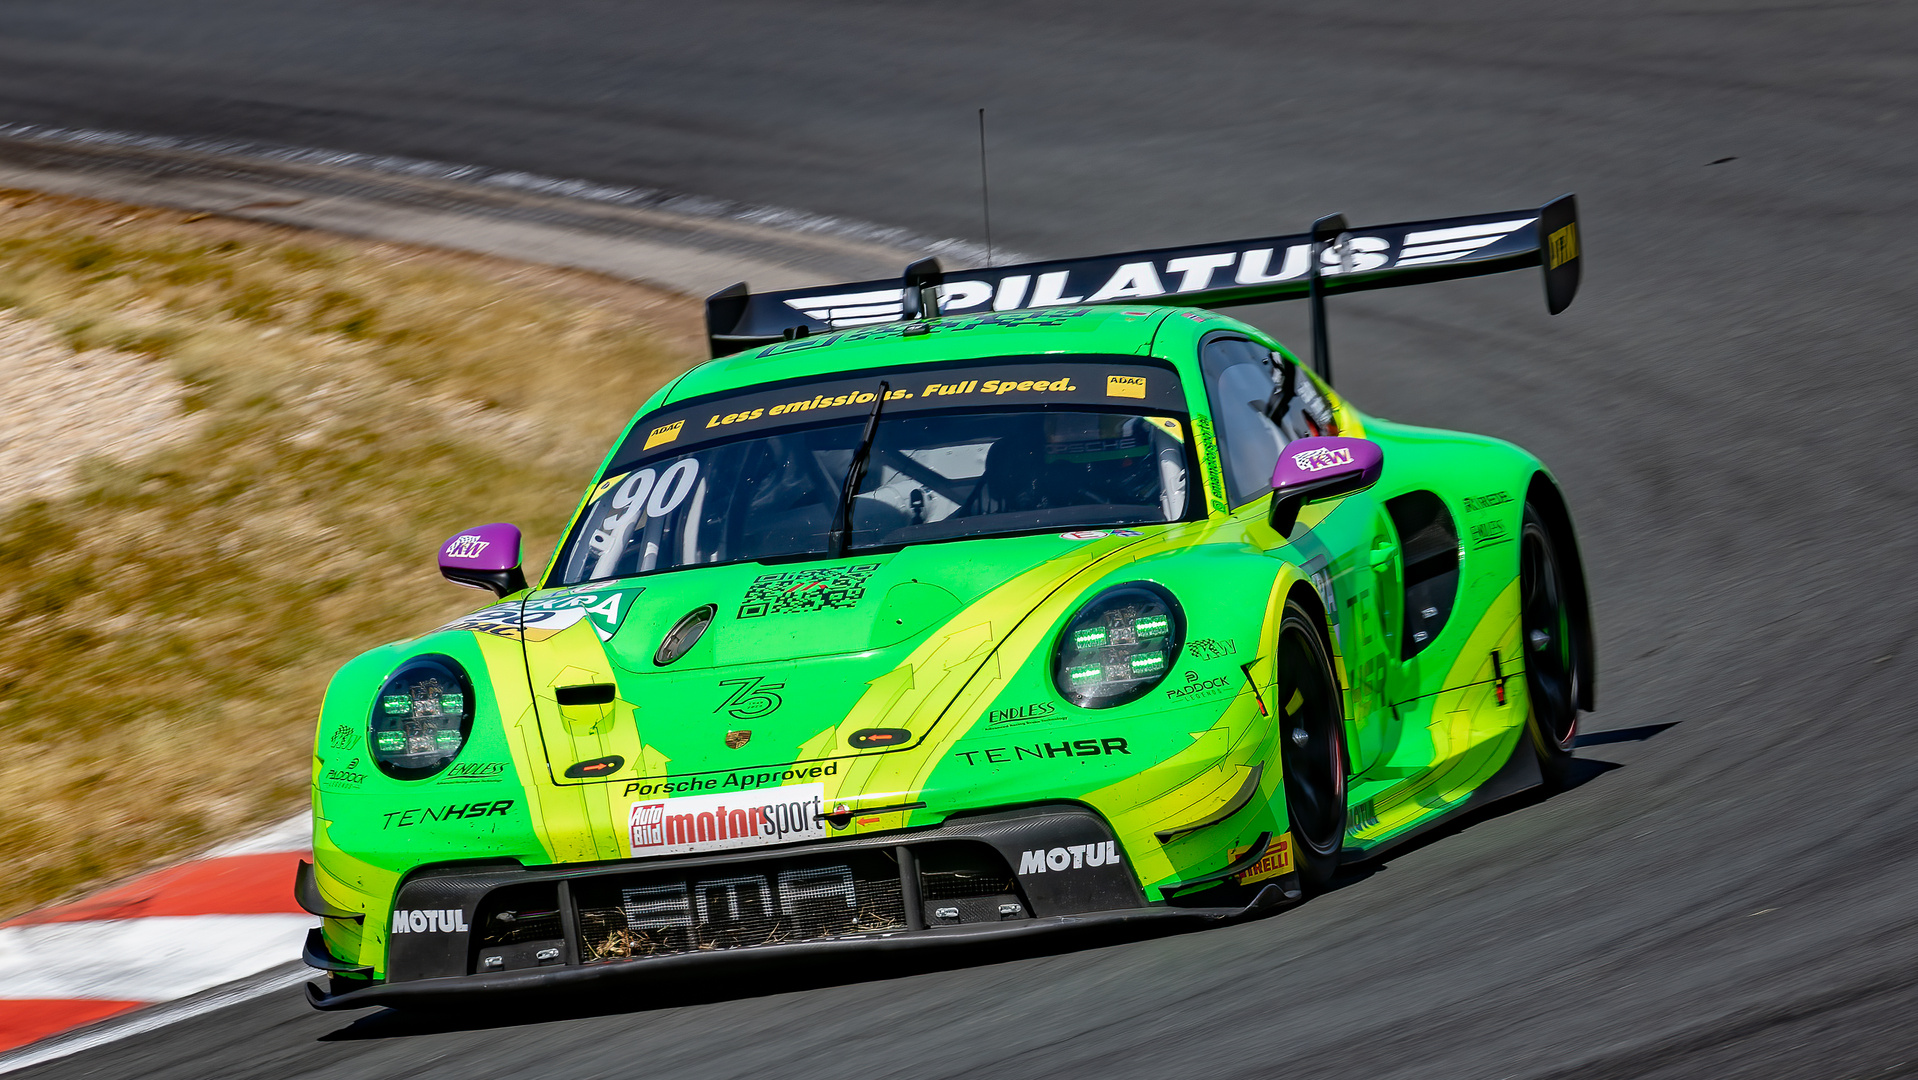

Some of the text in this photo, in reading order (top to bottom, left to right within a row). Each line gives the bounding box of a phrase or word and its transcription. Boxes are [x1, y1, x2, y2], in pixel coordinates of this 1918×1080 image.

[932, 236, 1390, 312] PILATUS
[1110, 377, 1144, 386] ADAC
[705, 376, 1077, 429] Less emissions. Full Speed.
[651, 421, 683, 437] ADAC
[1304, 447, 1354, 471] KW
[611, 457, 699, 518] 90
[447, 538, 490, 558] KW
[712, 676, 786, 719] 75
[1166, 675, 1230, 700] PADDOCK
[988, 701, 1055, 724] ENDLESS
[447, 762, 510, 776] ENDLESS
[623, 761, 838, 798] Porsche Approved
[631, 805, 664, 828] Auto
[665, 795, 824, 846] motorsport
[632, 823, 663, 847] Bild
[1018, 840, 1120, 876] MOTUL
[391, 908, 469, 934] MOTUL
